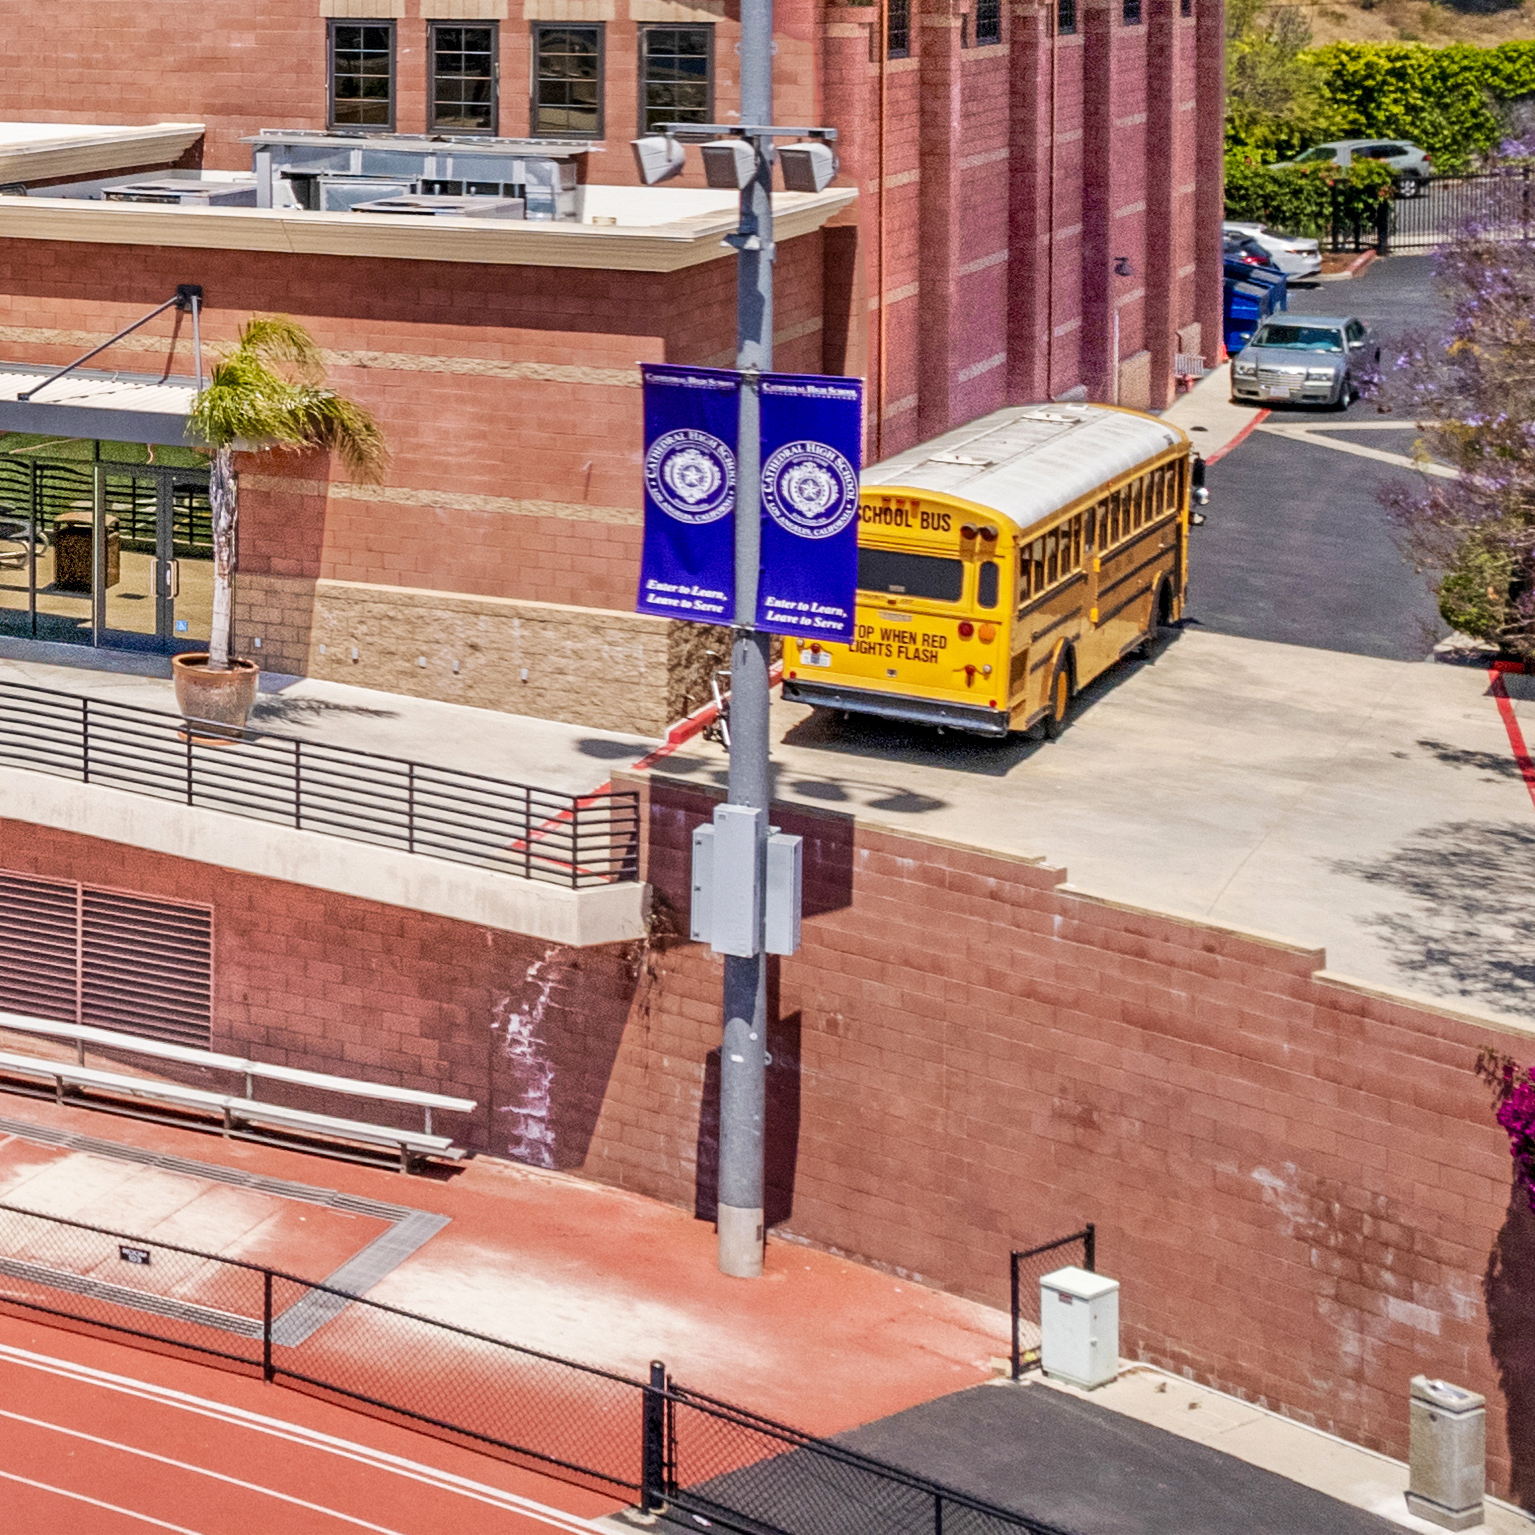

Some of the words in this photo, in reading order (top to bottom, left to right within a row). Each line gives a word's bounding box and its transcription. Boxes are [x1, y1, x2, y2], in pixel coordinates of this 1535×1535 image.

[646, 432, 688, 479] CATHEDRAL
[688, 431, 718, 451] HIGH
[717, 444, 736, 488] SCHOOL
[763, 445, 804, 493] CATHEDRAL
[806, 443, 837, 464] HIGH
[835, 455, 857, 502] SCHOOL
[813, 509, 853, 537] CALIFORNIA
[921, 511, 951, 532] BUS
[646, 579, 677, 593] Enter
[679, 584, 691, 595] to
[691, 585, 728, 601] Learn,
[646, 593, 679, 607] Leave
[681, 599, 692, 609] to
[693, 599, 724, 614] Serve
[765, 596, 796, 610] Enter
[797, 601, 809, 612] to
[811, 602, 848, 618] Learn,
[766, 610, 797, 624] Leave
[799, 616, 812, 627] to
[813, 616, 845, 631] Serve
[880, 627, 917, 646] WHEN
[922, 633, 947, 650] RED
[849, 639, 893, 658] LIGHTS
[897, 645, 939, 664] FLASH
